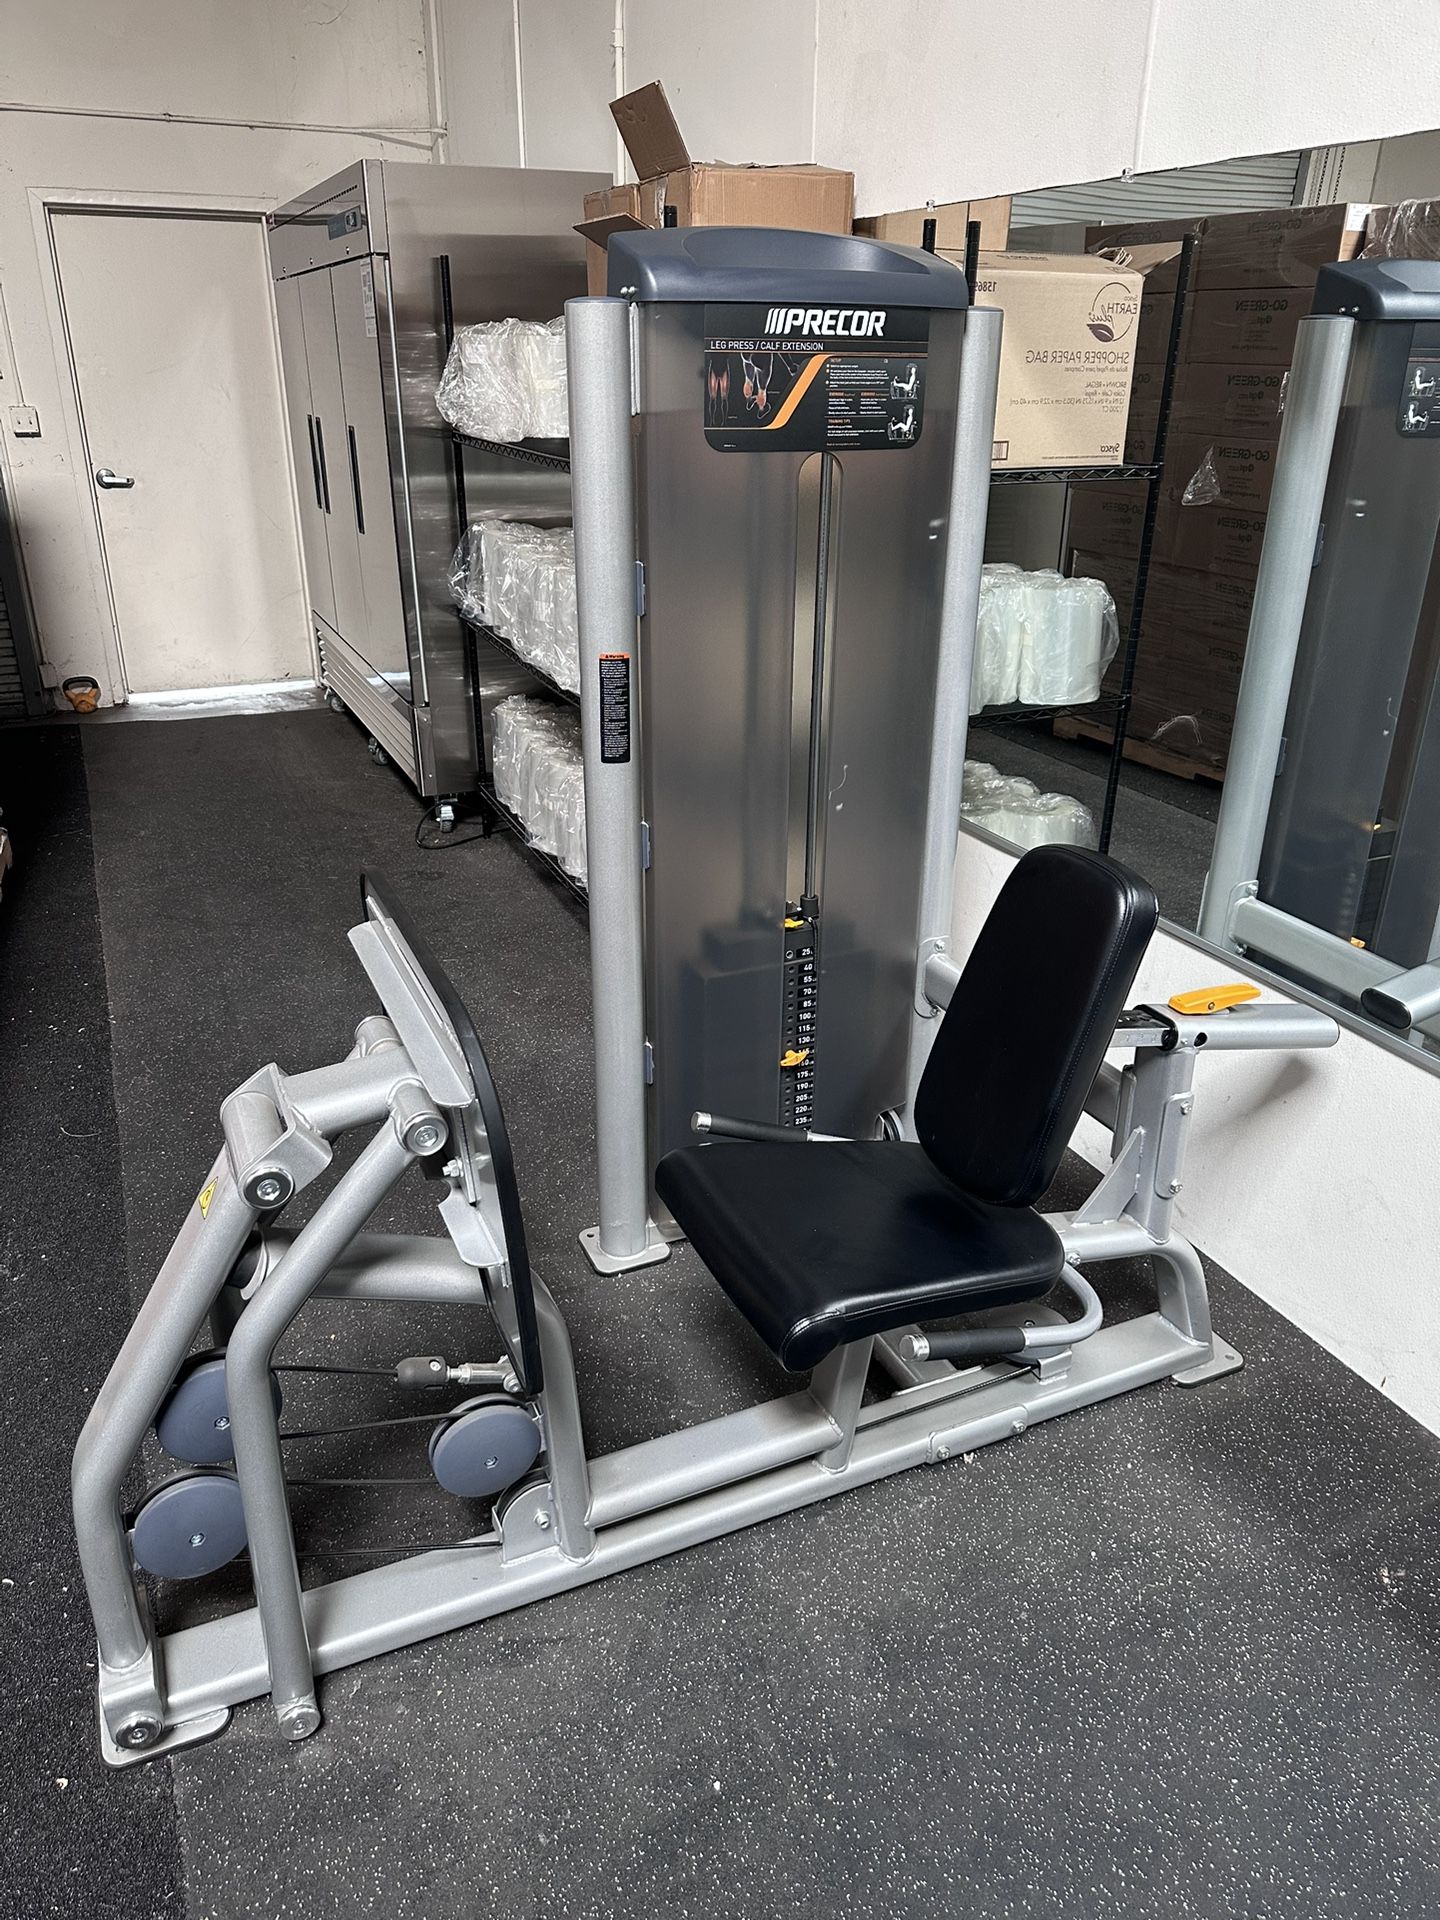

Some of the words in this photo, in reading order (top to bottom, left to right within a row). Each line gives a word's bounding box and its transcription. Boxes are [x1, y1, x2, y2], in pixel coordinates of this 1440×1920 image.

[782, 308, 887, 337] PRECOR
[710, 340, 727, 350] LEG
[728, 340, 754, 350] PRESS
[760, 341, 781, 350] CALF
[782, 341, 824, 351] EXTENSION
[801, 947, 811, 957] 25
[803, 963, 813, 971] 40
[803, 975, 813, 983] 55
[803, 987, 812, 996] 70
[803, 999, 812, 1008] 85
[799, 1012, 811, 1021] 100
[798, 1024, 811, 1034] 115
[798, 1036, 810, 1045] 130
[797, 1070, 809, 1079] 175
[796, 1082, 809, 1091] 190
[795, 1094, 808, 1102] 205
[795, 1105, 808, 1114] 220
[795, 1116, 807, 1125] 235
